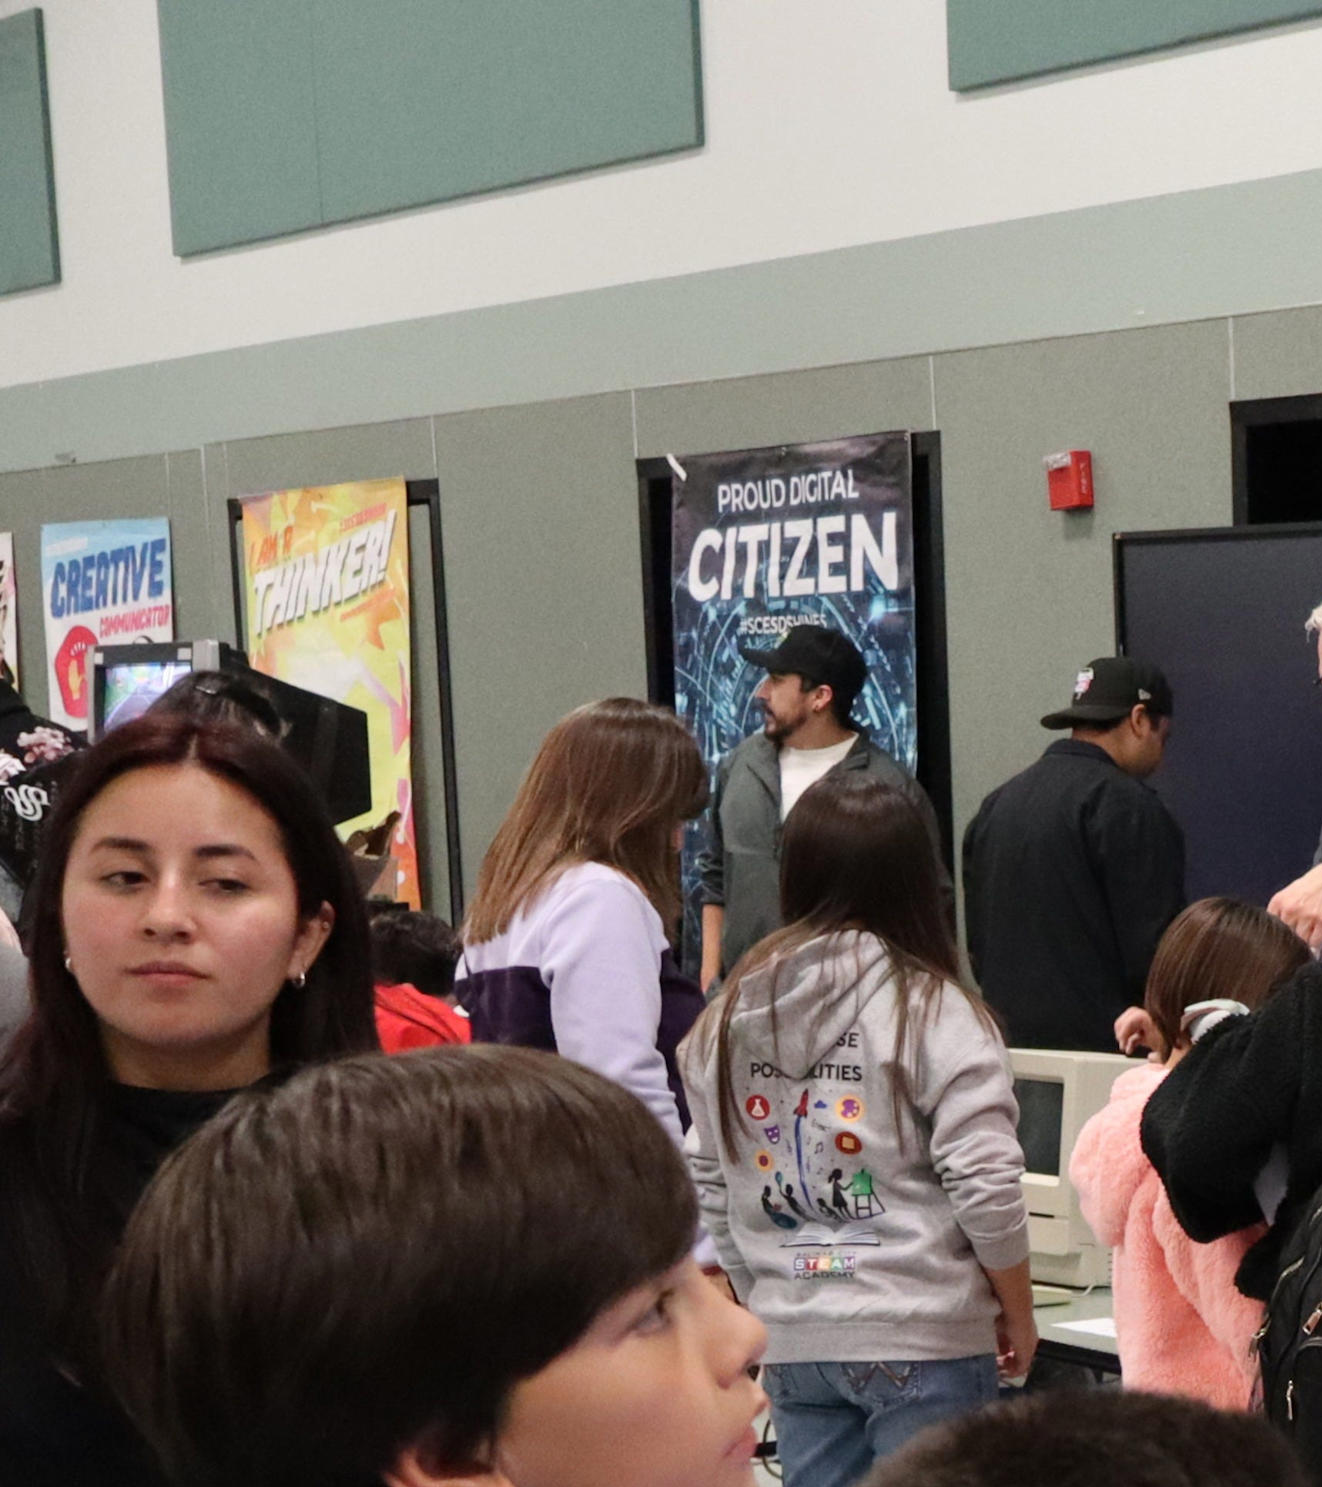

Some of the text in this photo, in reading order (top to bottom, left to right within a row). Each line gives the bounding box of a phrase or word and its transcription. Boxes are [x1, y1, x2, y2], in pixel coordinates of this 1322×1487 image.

[718, 469, 860, 513] PROUD DIGITAL
[51, 538, 167, 619] CREATIVE
[254, 508, 398, 640] THINKER!
[688, 511, 899, 602] CITIZEN
[794, 1256, 856, 1271] STEAM
